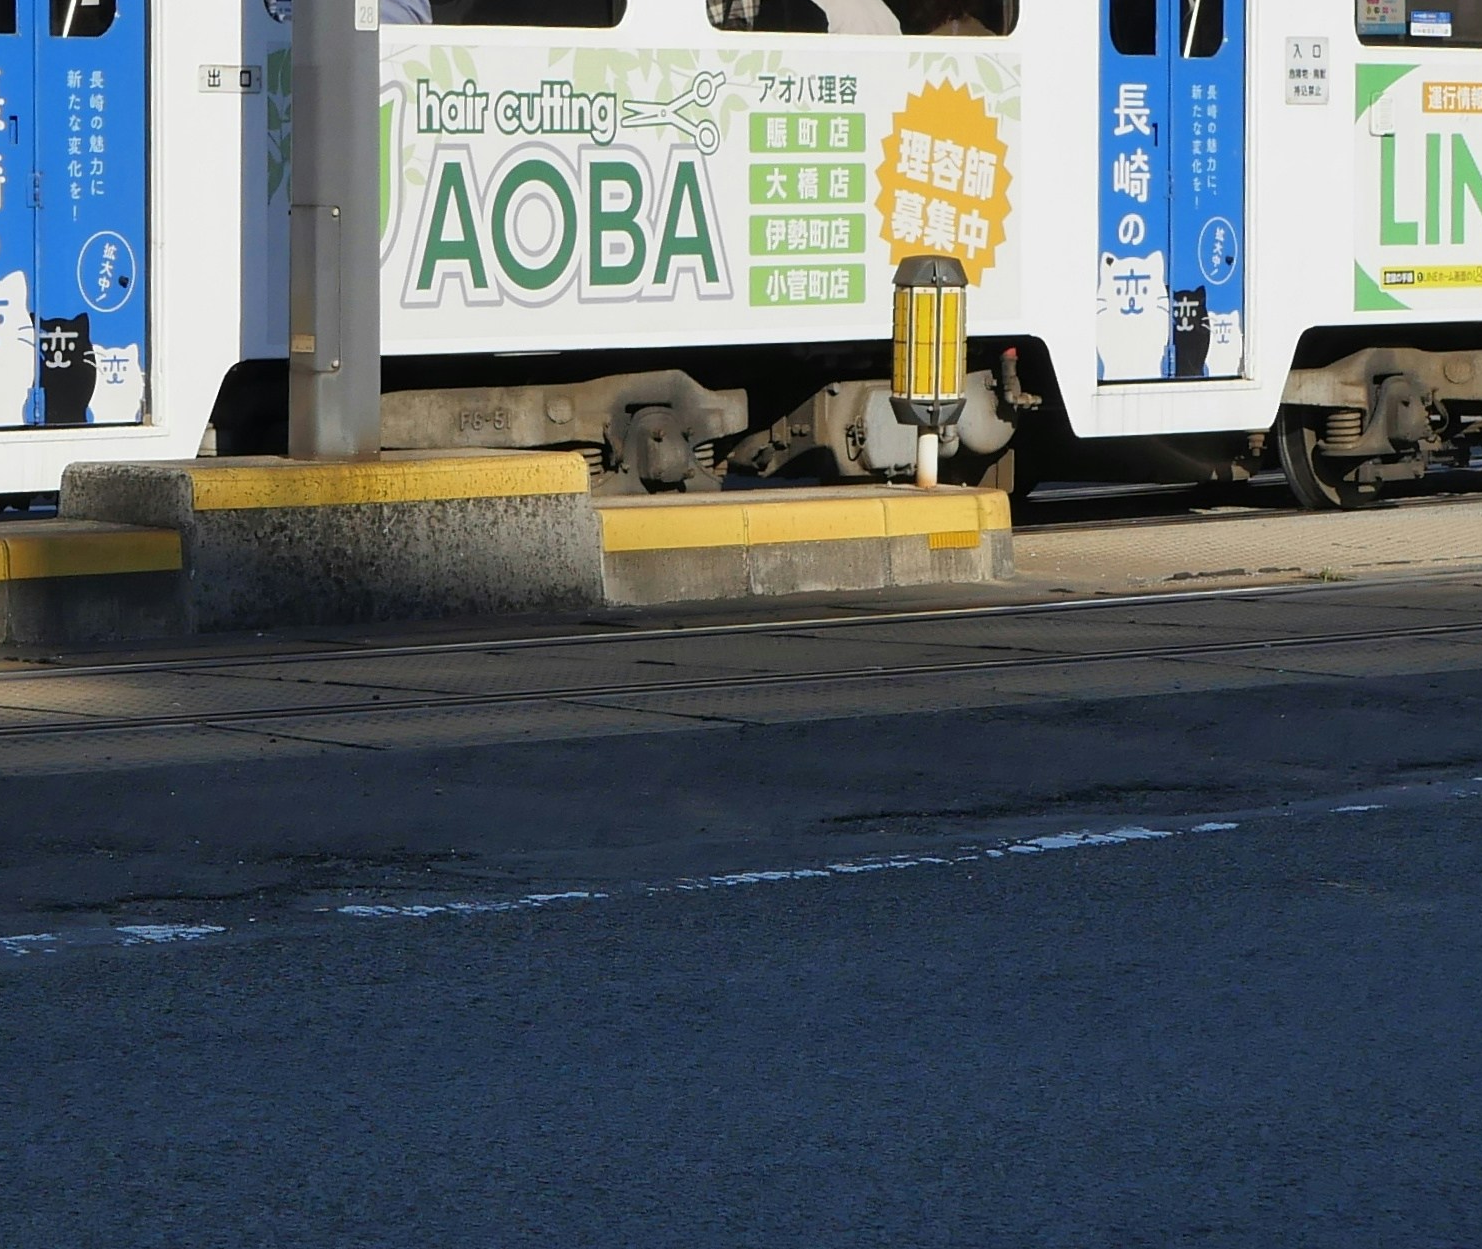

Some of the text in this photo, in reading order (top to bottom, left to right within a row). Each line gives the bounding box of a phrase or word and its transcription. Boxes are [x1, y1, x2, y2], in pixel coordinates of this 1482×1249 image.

[207, 68, 253, 88] 出口
[757, 74, 858, 105] アオバ理容
[88, 70, 106, 197] 長崎の魅力に
[416, 78, 618, 147] hair cutting
[765, 167, 850, 200] 大橋店
[896, 127, 998, 202] 理容師
[411, 154, 726, 298] AOBA
[764, 217, 851, 251] 伊勢町店
[890, 188, 990, 260] 募集中
[765, 268, 850, 303] 小菅町店
